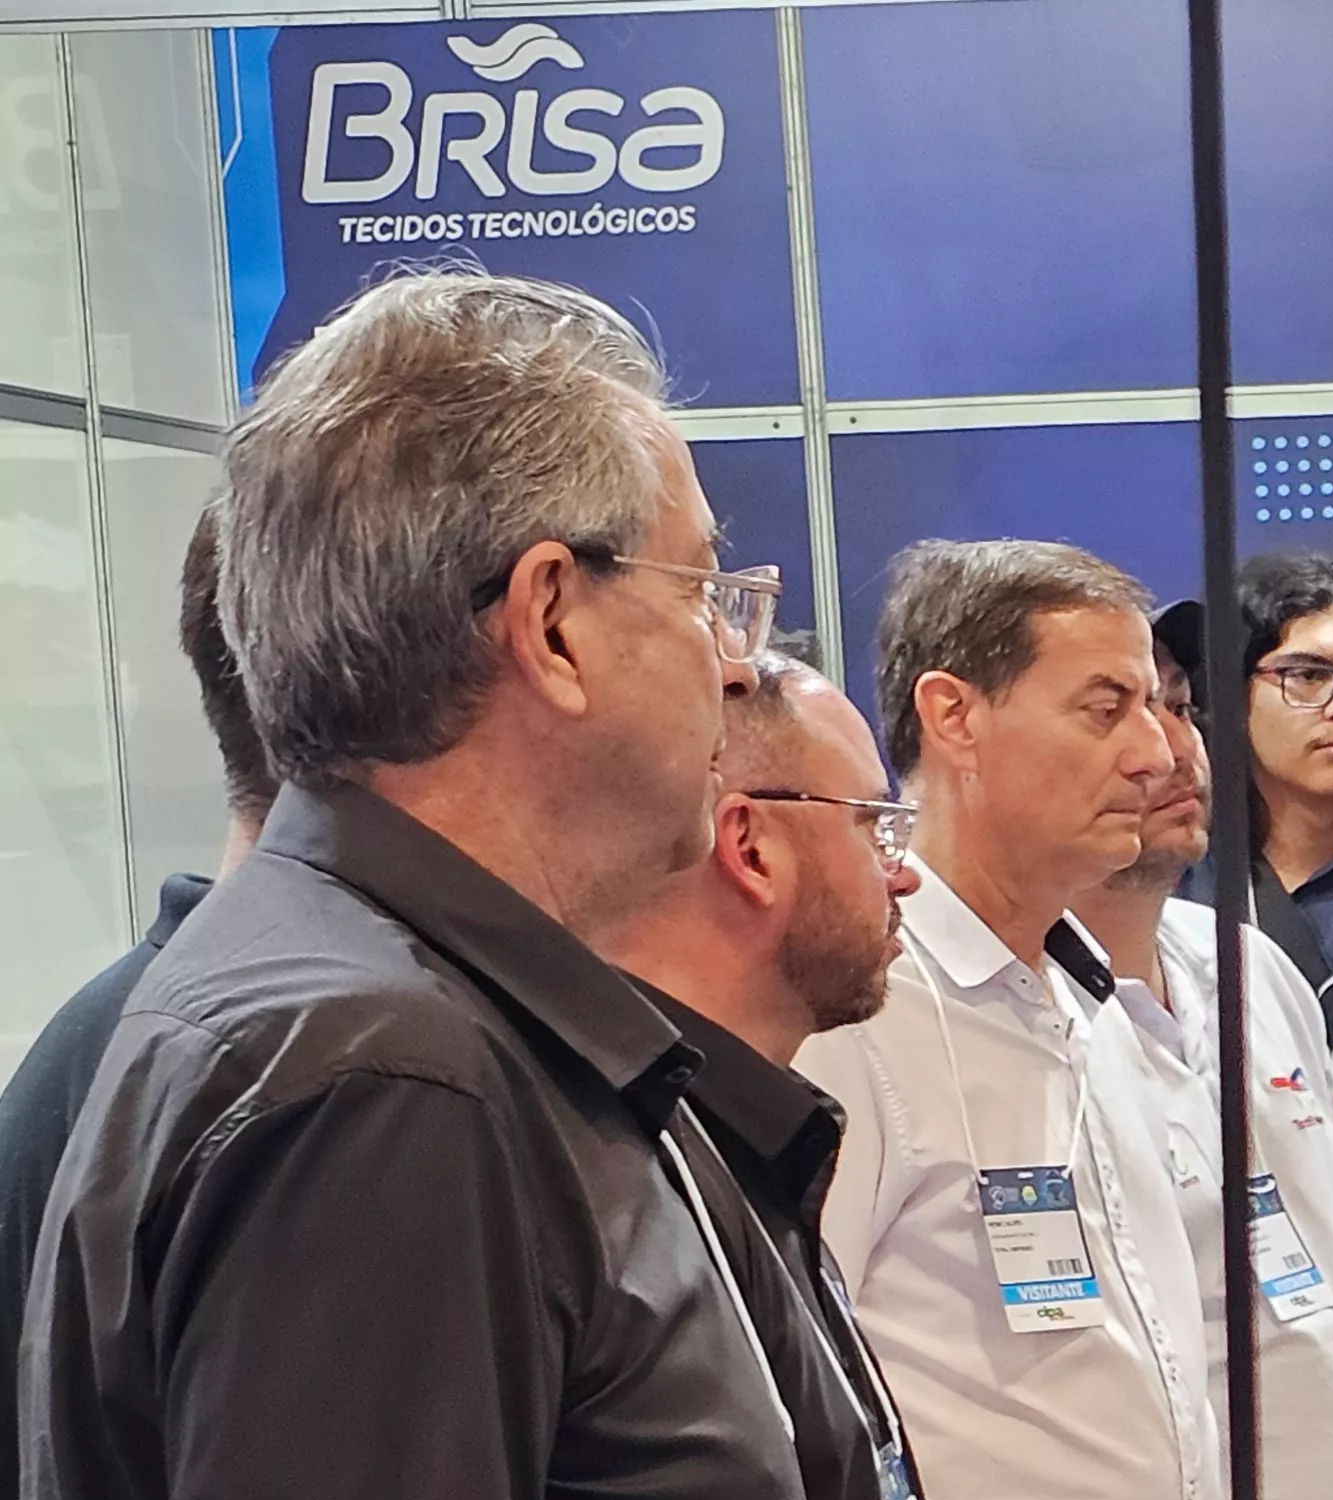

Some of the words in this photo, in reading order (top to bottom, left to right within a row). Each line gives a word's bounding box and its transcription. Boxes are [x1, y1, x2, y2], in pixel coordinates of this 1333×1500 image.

[338, 214, 464, 244] TECIDOS
[467, 203, 697, 240] TECNOLÓGICOS
[1016, 1281, 1086, 1301] VISITANTE
